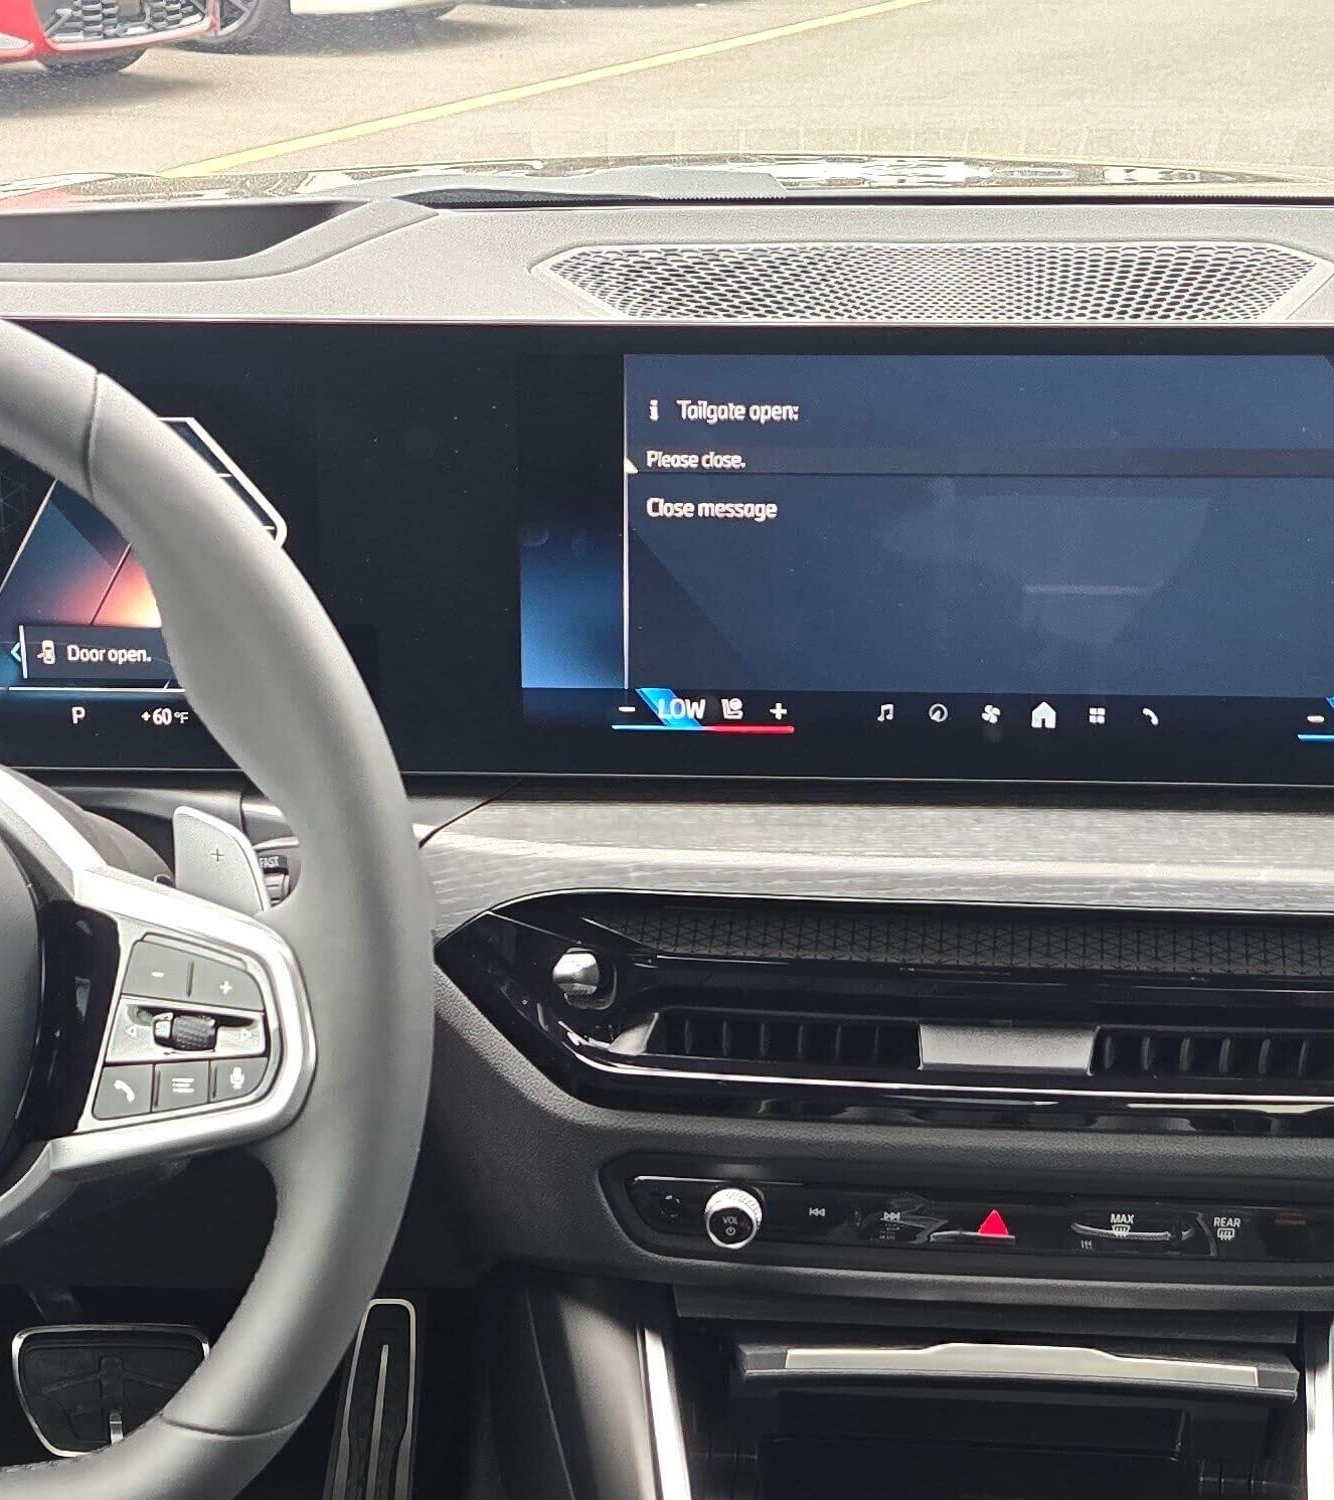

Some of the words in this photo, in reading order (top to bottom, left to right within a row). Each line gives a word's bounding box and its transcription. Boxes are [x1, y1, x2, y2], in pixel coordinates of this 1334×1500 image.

[677, 400, 746, 424] Tailgate
[646, 451, 699, 468] Please
[646, 498, 694, 518] Close
[697, 502, 778, 521] message
[67, 645, 102, 662] Door
[108, 647, 152, 667] open.
[72, 707, 86, 724] P
[658, 698, 706, 719] LOW
[1110, 1213, 1134, 1225] MAX
[1213, 1216, 1241, 1229] REAR
